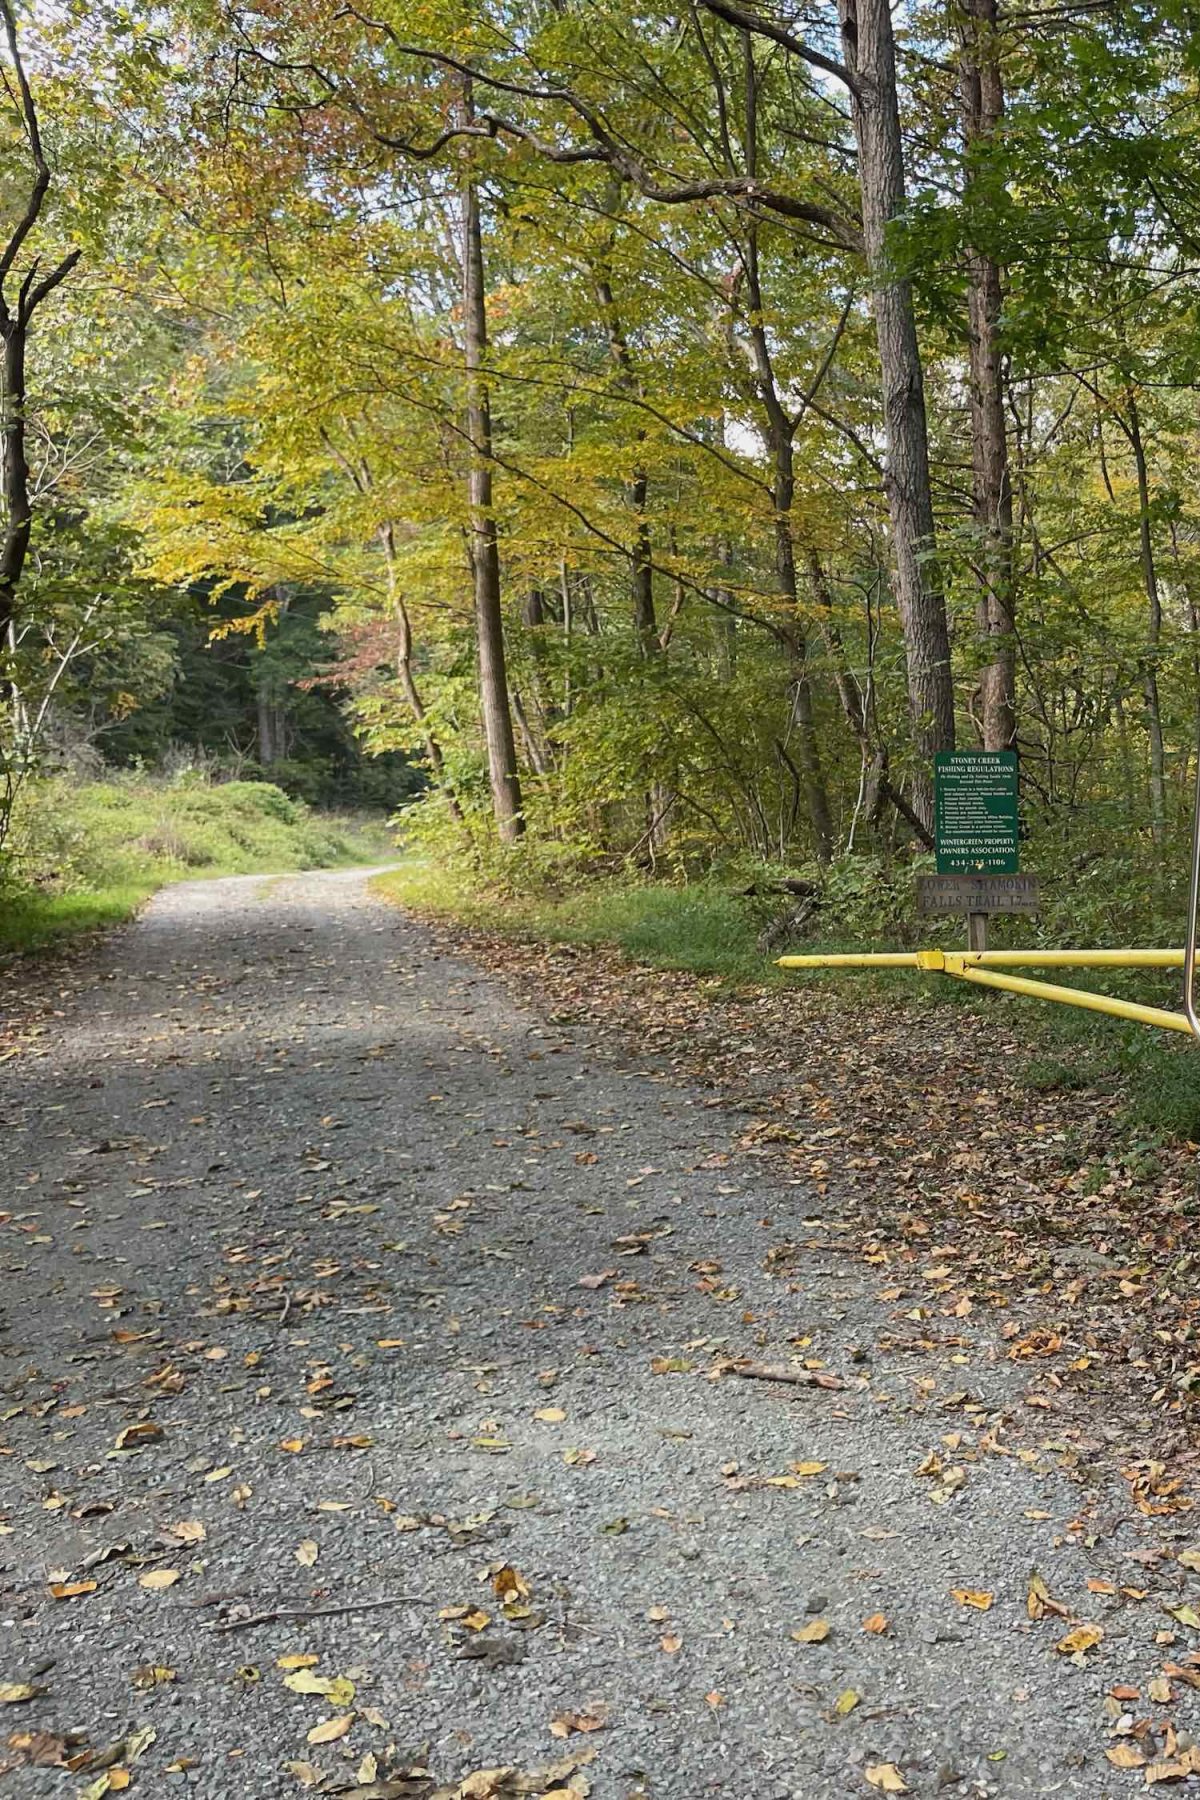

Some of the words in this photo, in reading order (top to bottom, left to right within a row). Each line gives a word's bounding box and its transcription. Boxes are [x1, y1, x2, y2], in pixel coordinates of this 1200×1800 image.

[950, 757, 977, 765] STONEY
[978, 757, 1001, 765] CREEK
[938, 765, 966, 773] FISHING
[967, 765, 1014, 773] REGULATIONS
[940, 838, 984, 846] WINTERGREEN
[984, 837, 1015, 845] PROPERTY
[940, 847, 970, 855] OWNERS
[970, 846, 1016, 854] ASSOCIATION
[922, 895, 963, 908] FALLS
[966, 895, 1004, 908] TRAIL
